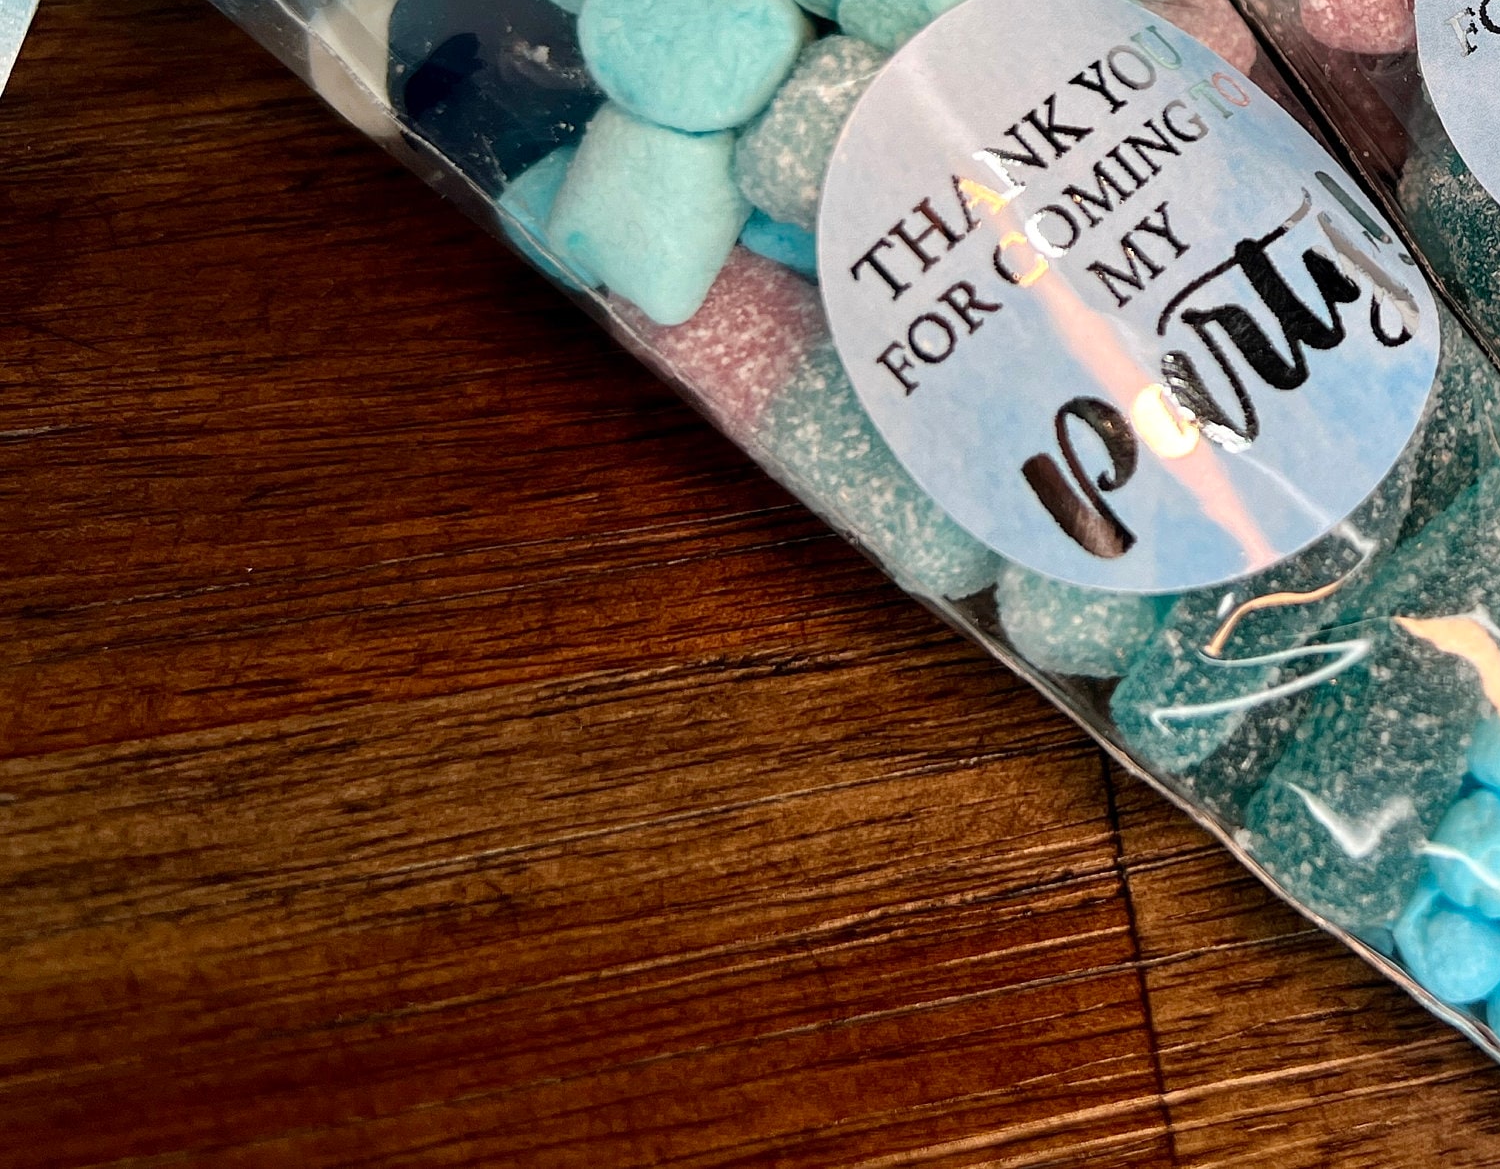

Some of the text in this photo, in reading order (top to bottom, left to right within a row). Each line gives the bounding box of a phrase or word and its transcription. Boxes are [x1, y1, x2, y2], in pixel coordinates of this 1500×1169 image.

[850, 24, 1185, 302] THANK YOU
[876, 71, 1251, 398] FOR COMING TO
[1086, 201, 1193, 309] MY
